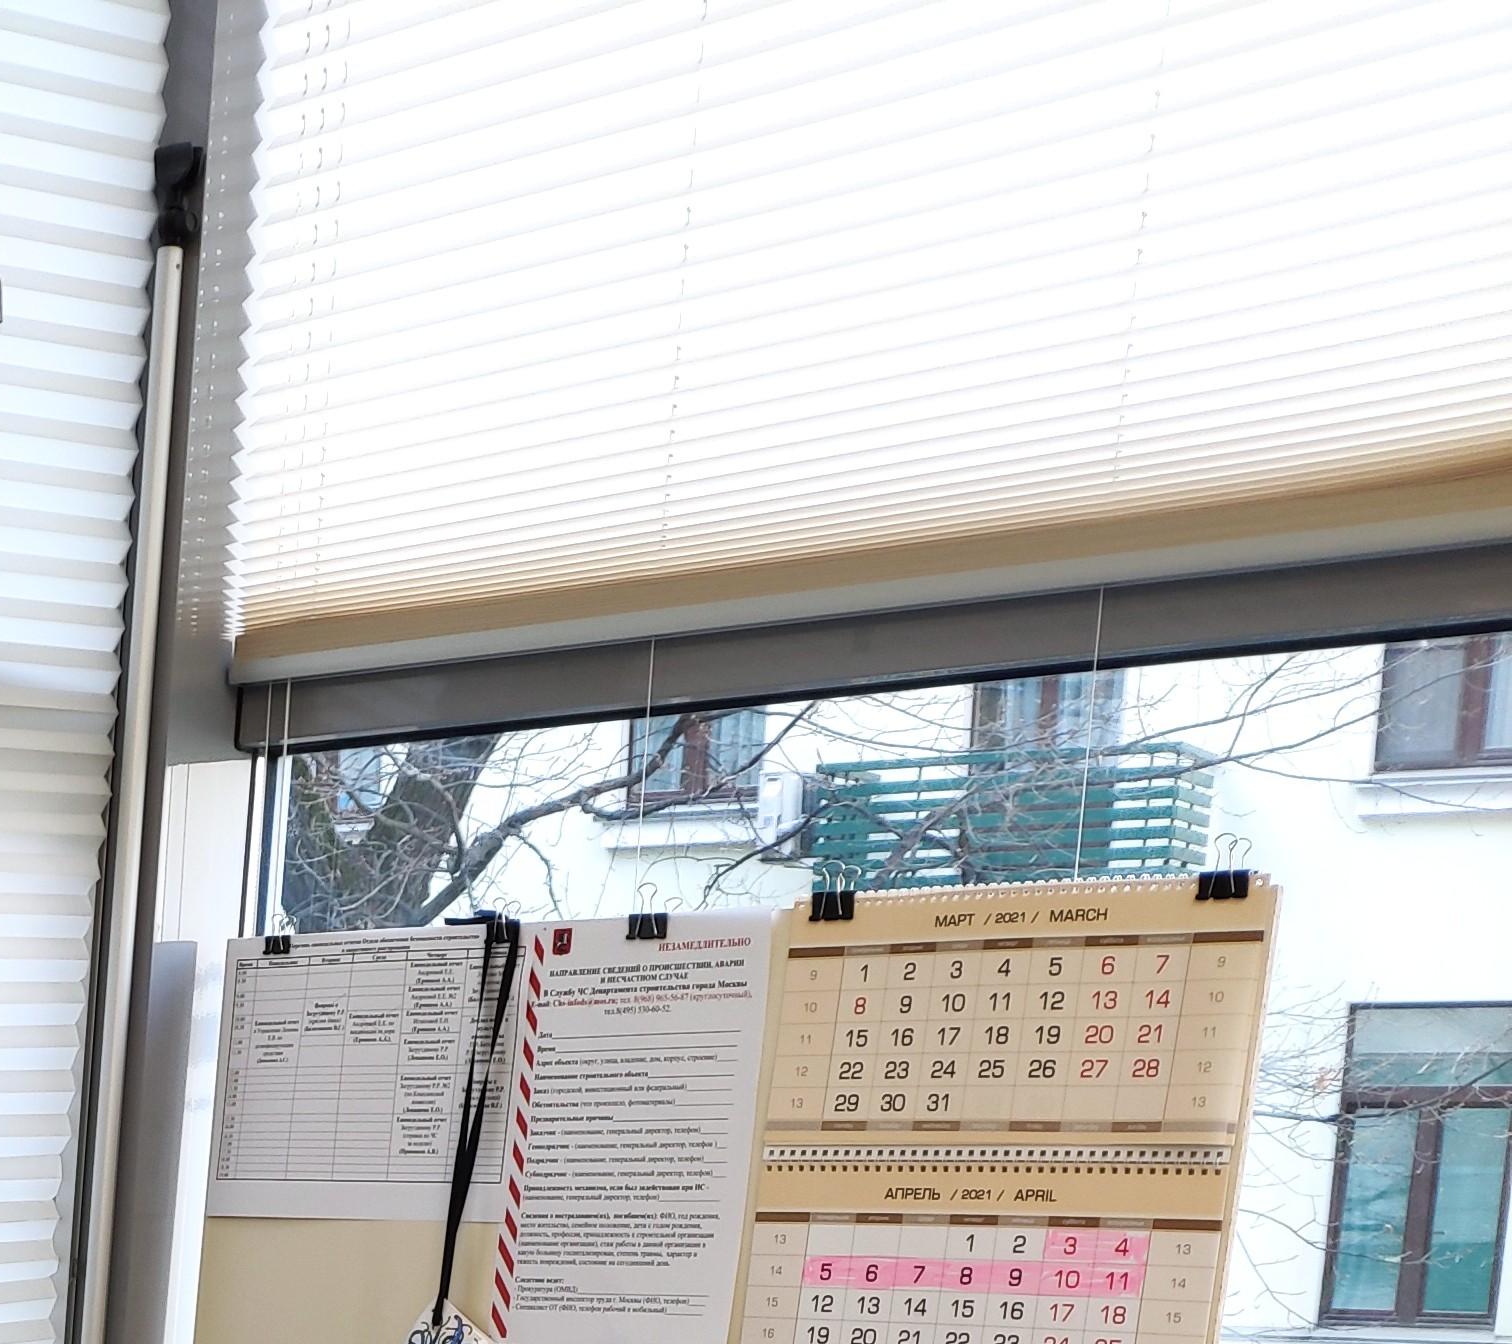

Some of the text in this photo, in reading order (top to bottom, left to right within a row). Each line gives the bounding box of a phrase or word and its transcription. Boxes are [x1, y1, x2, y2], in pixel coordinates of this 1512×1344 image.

[935, 908, 1108, 928] МАРТ 2021 MARCH
[659, 938, 751, 952] НЕЗАМЕДЛИТЕЛЬНО
[549, 968, 600, 977] НАПРАВЛЕНИЕ
[603, 964, 640, 974] СВЕДЕНИЙ
[860, 954, 1170, 983] 1 2 3 4 5 6 7
[590, 986, 637, 996] Департамента
[639, 984, 690, 993] строительства
[692, 982, 715, 991] города
[718, 980, 747, 988] Москвы
[853, 989, 1171, 1015] 8 9 10 11 12 13 14
[845, 1024, 1163, 1048] 15 16 17 18 19 20 21
[838, 1058, 1160, 1080] 22 23 24 25 26 27 28
[833, 1093, 950, 1112] 29 30 31
[884, 1187, 1057, 1203] АПРЕЛЬ 2021 APRIL
[966, 1233, 1130, 1257] 1 2 3 4
[819, 1262, 1129, 1291] 5 6 7 8 9 10 11
[811, 1294, 1127, 1325] 12 13 14 15 16 17 18
[807, 1325, 830, 1344] 19
